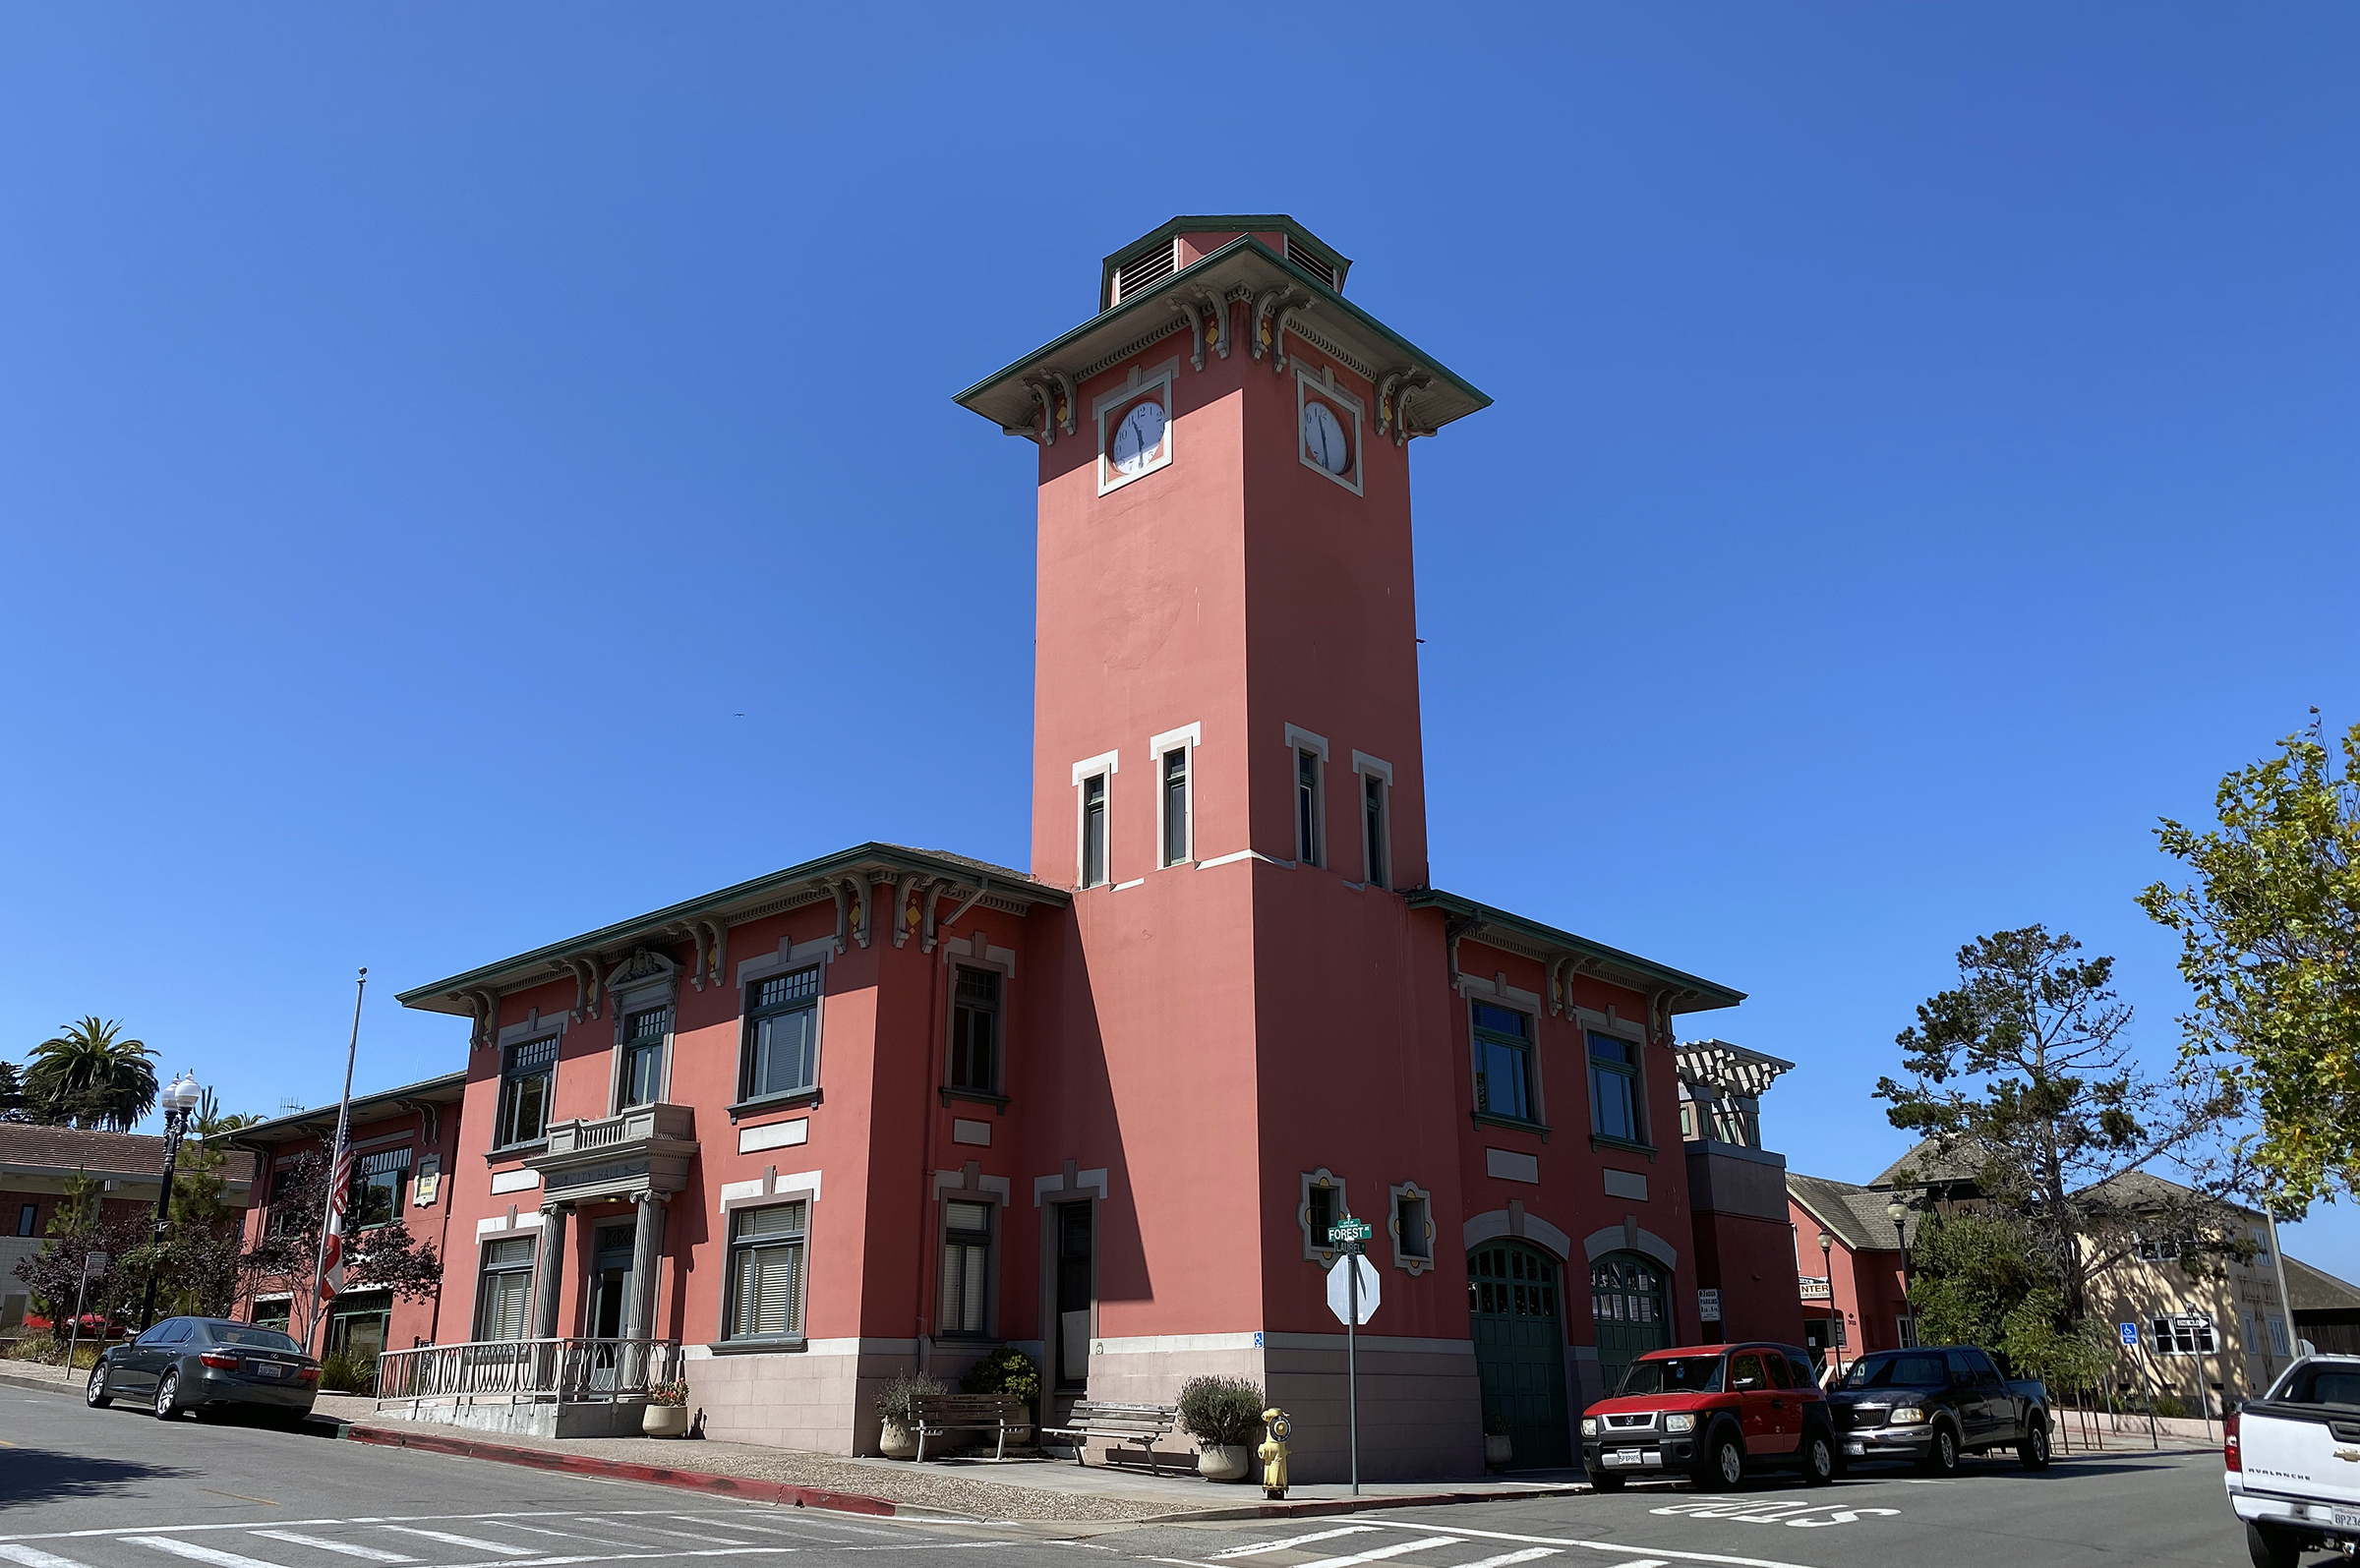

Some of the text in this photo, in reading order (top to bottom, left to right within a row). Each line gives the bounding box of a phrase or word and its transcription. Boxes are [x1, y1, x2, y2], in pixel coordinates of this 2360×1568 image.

[1137, 407, 1145, 419] 12
[1119, 430, 1127, 442] 10
[571, 1167, 619, 1184] CITY HALL
[1329, 1228, 1363, 1240] FOREST
[1337, 1241, 1362, 1254] LAUREL
[2248, 1468, 2310, 1481] AVALANCHE
[1648, 1498, 1902, 1527] STOP
